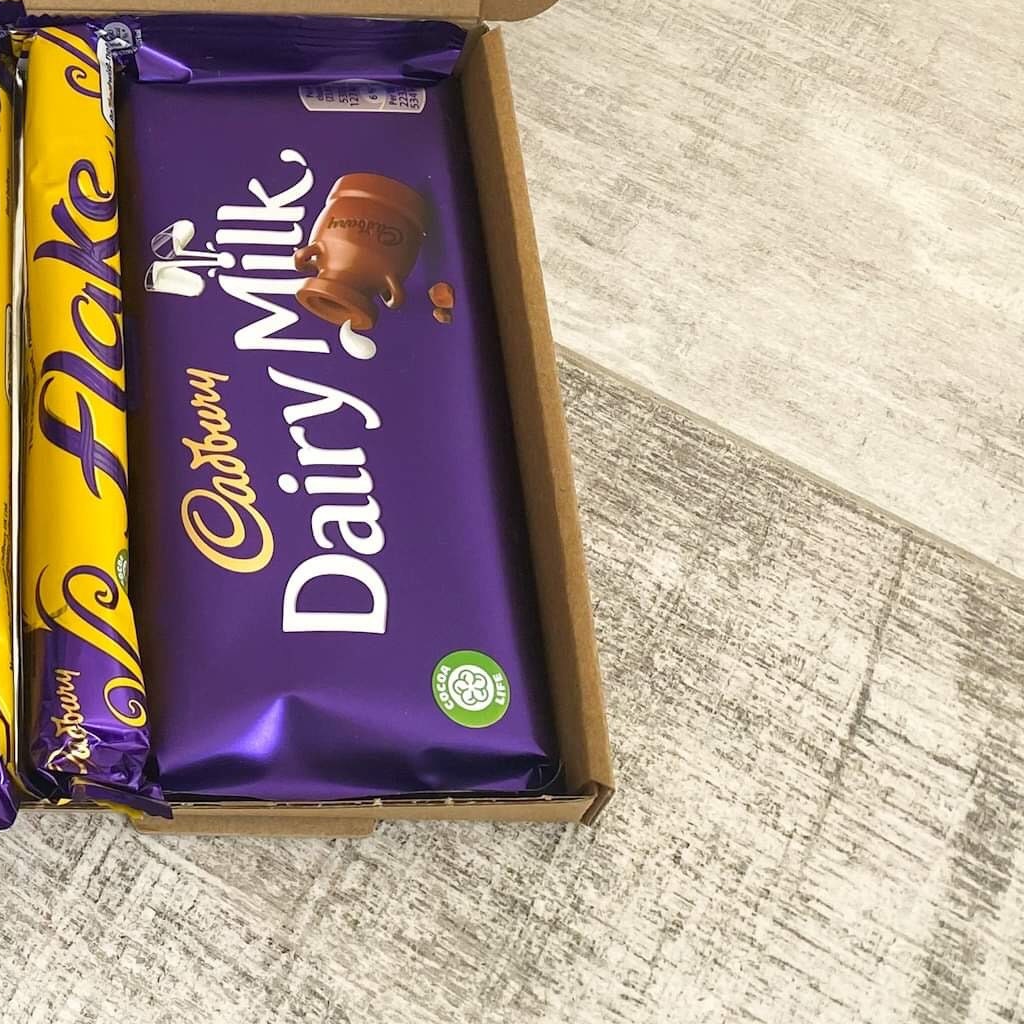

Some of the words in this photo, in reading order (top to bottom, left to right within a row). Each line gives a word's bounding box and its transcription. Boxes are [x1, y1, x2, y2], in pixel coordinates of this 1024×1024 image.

[34, 141, 128, 526] Flake
[215, 148, 331, 354] Milk
[181, 367, 275, 574] Cadbury
[267, 366, 388, 635] Dairy
[436, 665, 454, 710] COCOA
[492, 673, 506, 705] LIFE
